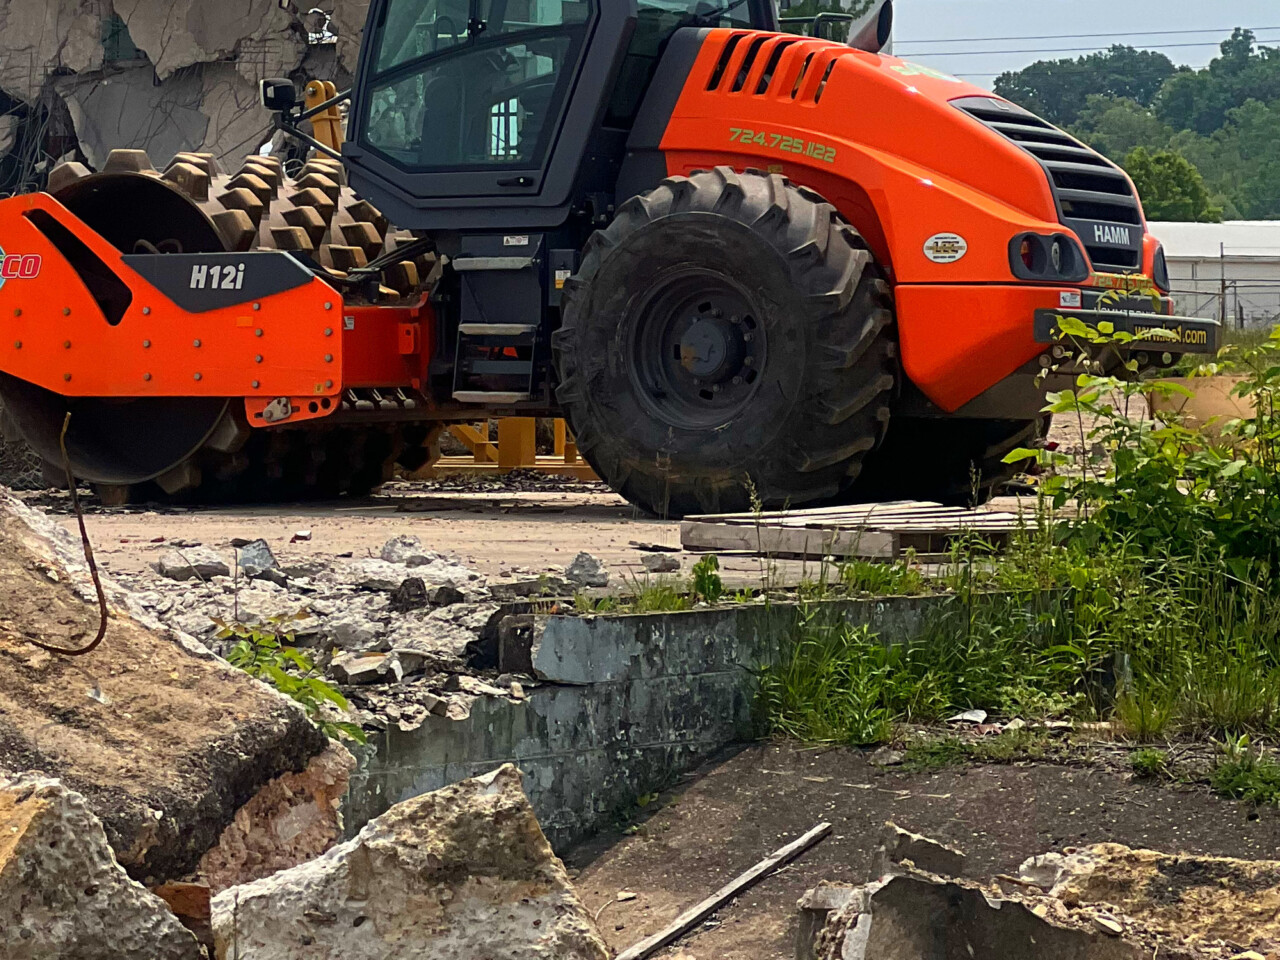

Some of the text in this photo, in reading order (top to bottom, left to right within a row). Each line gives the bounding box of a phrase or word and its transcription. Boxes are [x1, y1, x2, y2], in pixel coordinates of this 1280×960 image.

[729, 127, 837, 163] 724.725.1122
[1093, 224, 1131, 246] HAMM
[190, 262, 246, 290] H12i
